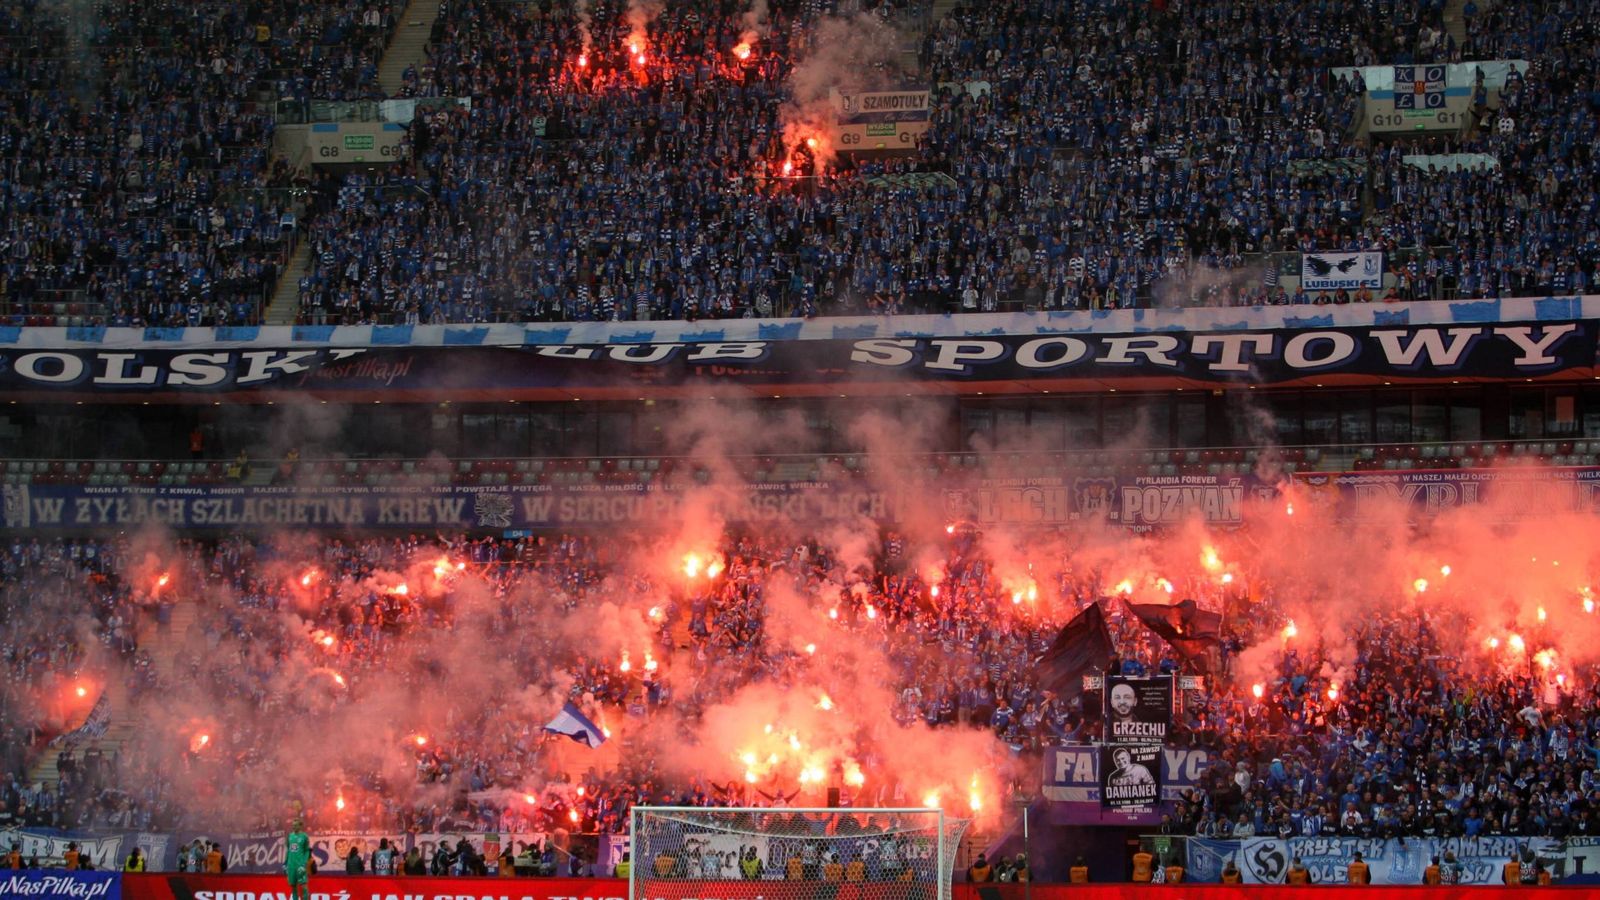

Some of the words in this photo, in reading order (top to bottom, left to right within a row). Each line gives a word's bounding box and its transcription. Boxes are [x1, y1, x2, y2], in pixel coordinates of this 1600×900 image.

[864, 95, 925, 109] SZAMOTUŁY
[1373, 115, 1402, 126] G10
[1437, 112, 1464, 123] G11
[841, 133, 860, 145] G9
[900, 132, 926, 144] G1
[320, 146, 338, 157] G8
[380, 145, 400, 157] G9
[1305, 280, 1359, 288] LUBUSKI
[850, 323, 1576, 372] SPORTOWY
[1134, 476, 1178, 485] PYRLANDIA
[1180, 475, 1216, 484] FOREVER
[1444, 473, 1470, 481] MAŁEJ
[978, 487, 1068, 524] LECH
[1121, 477, 1244, 523] POZNAŃ
[33, 497, 65, 523] W
[75, 497, 186, 523] ŻYŁACH
[191, 497, 364, 524] SZLACHETNA
[377, 497, 466, 524] KREW
[522, 495, 553, 522] W
[559, 495, 645, 522] SERCU
[819, 492, 886, 520] LECH
[1113, 722, 1166, 736] GRZECHU
[1105, 784, 1157, 799] DAMIANEK
[1289, 838, 1386, 859] KRYSTEK
